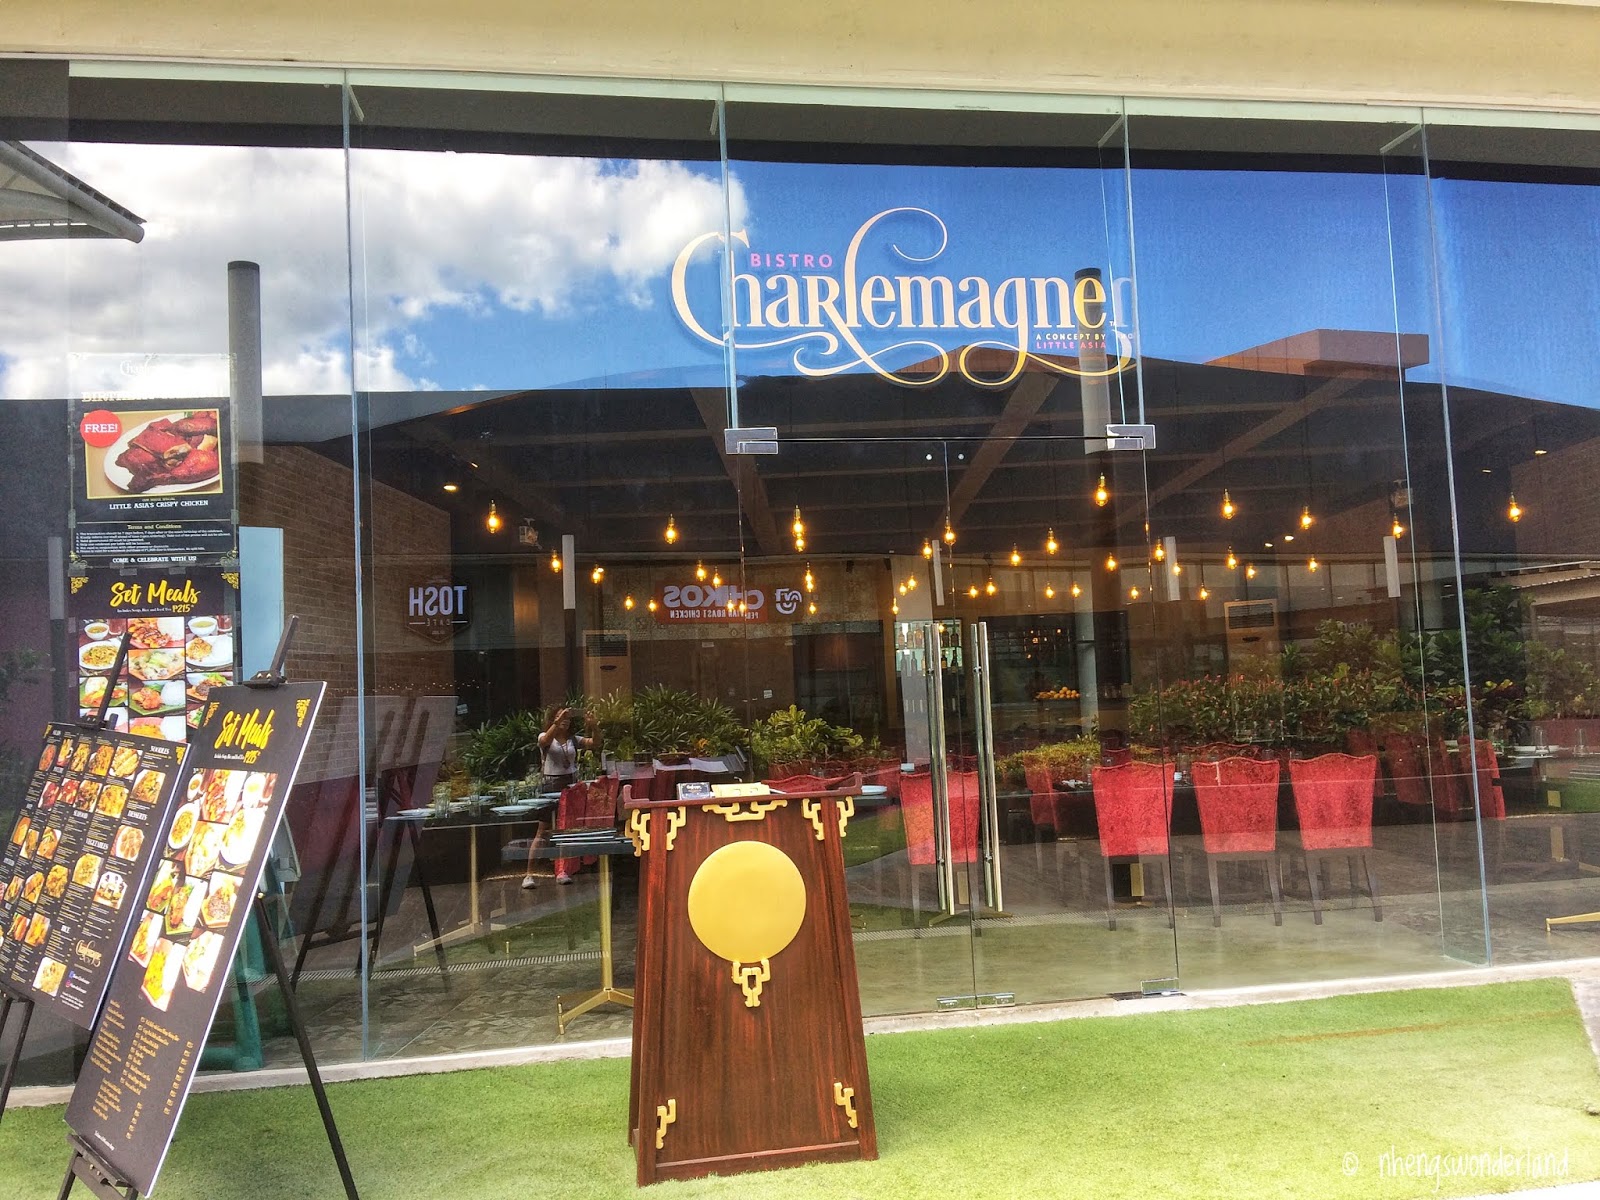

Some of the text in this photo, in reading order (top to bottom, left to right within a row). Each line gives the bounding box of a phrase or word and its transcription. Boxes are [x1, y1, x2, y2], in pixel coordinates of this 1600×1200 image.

[750, 253, 833, 268] BISTRO
[84, 424, 118, 433] FREE!
[110, 580, 200, 607] Set Meals
[214, 708, 274, 750] Set Meals
